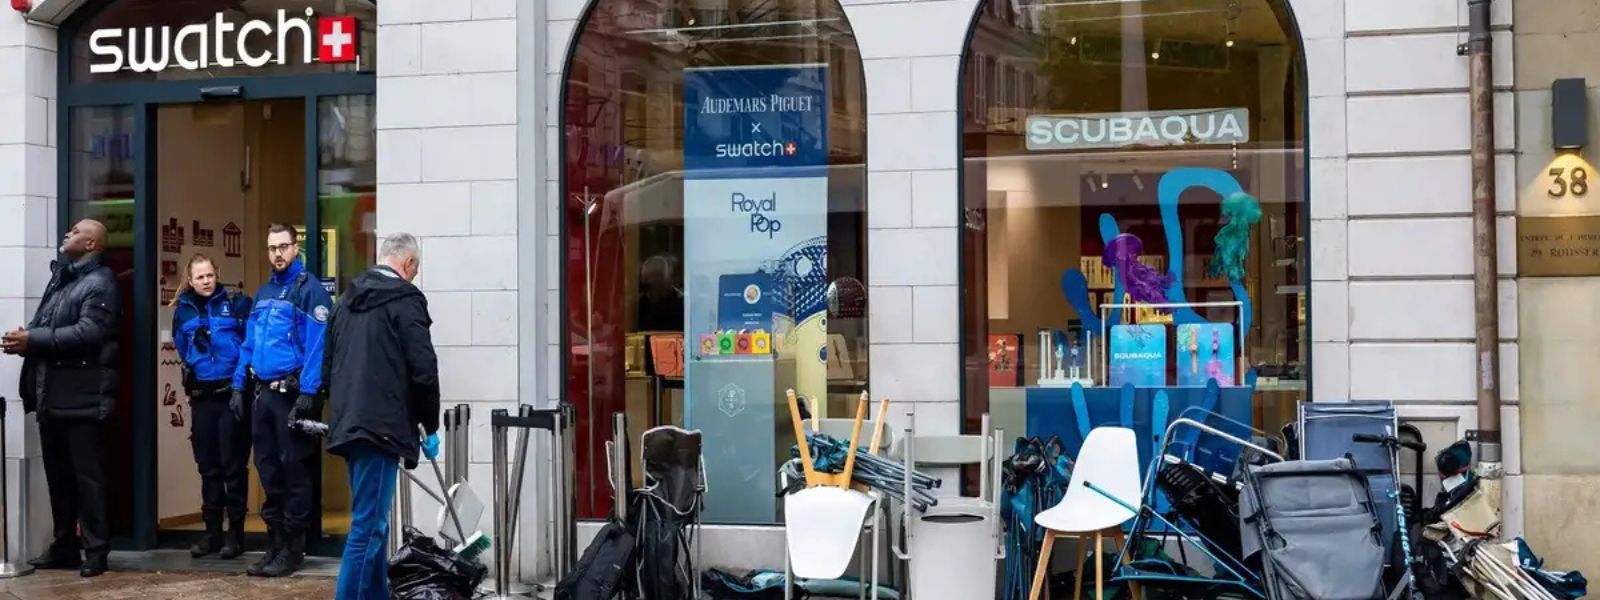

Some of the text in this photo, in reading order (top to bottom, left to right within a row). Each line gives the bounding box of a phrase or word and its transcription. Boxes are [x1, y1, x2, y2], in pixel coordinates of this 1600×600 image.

[89, 8, 312, 73] swatch
[700, 94, 813, 114] AUDEMARS PIGUET
[1029, 112, 1244, 144] SCUBAQUA
[715, 140, 784, 157] swatch
[1547, 166, 1589, 197] 38
[731, 192, 776, 214] Royal
[751, 213, 781, 239] Pop
